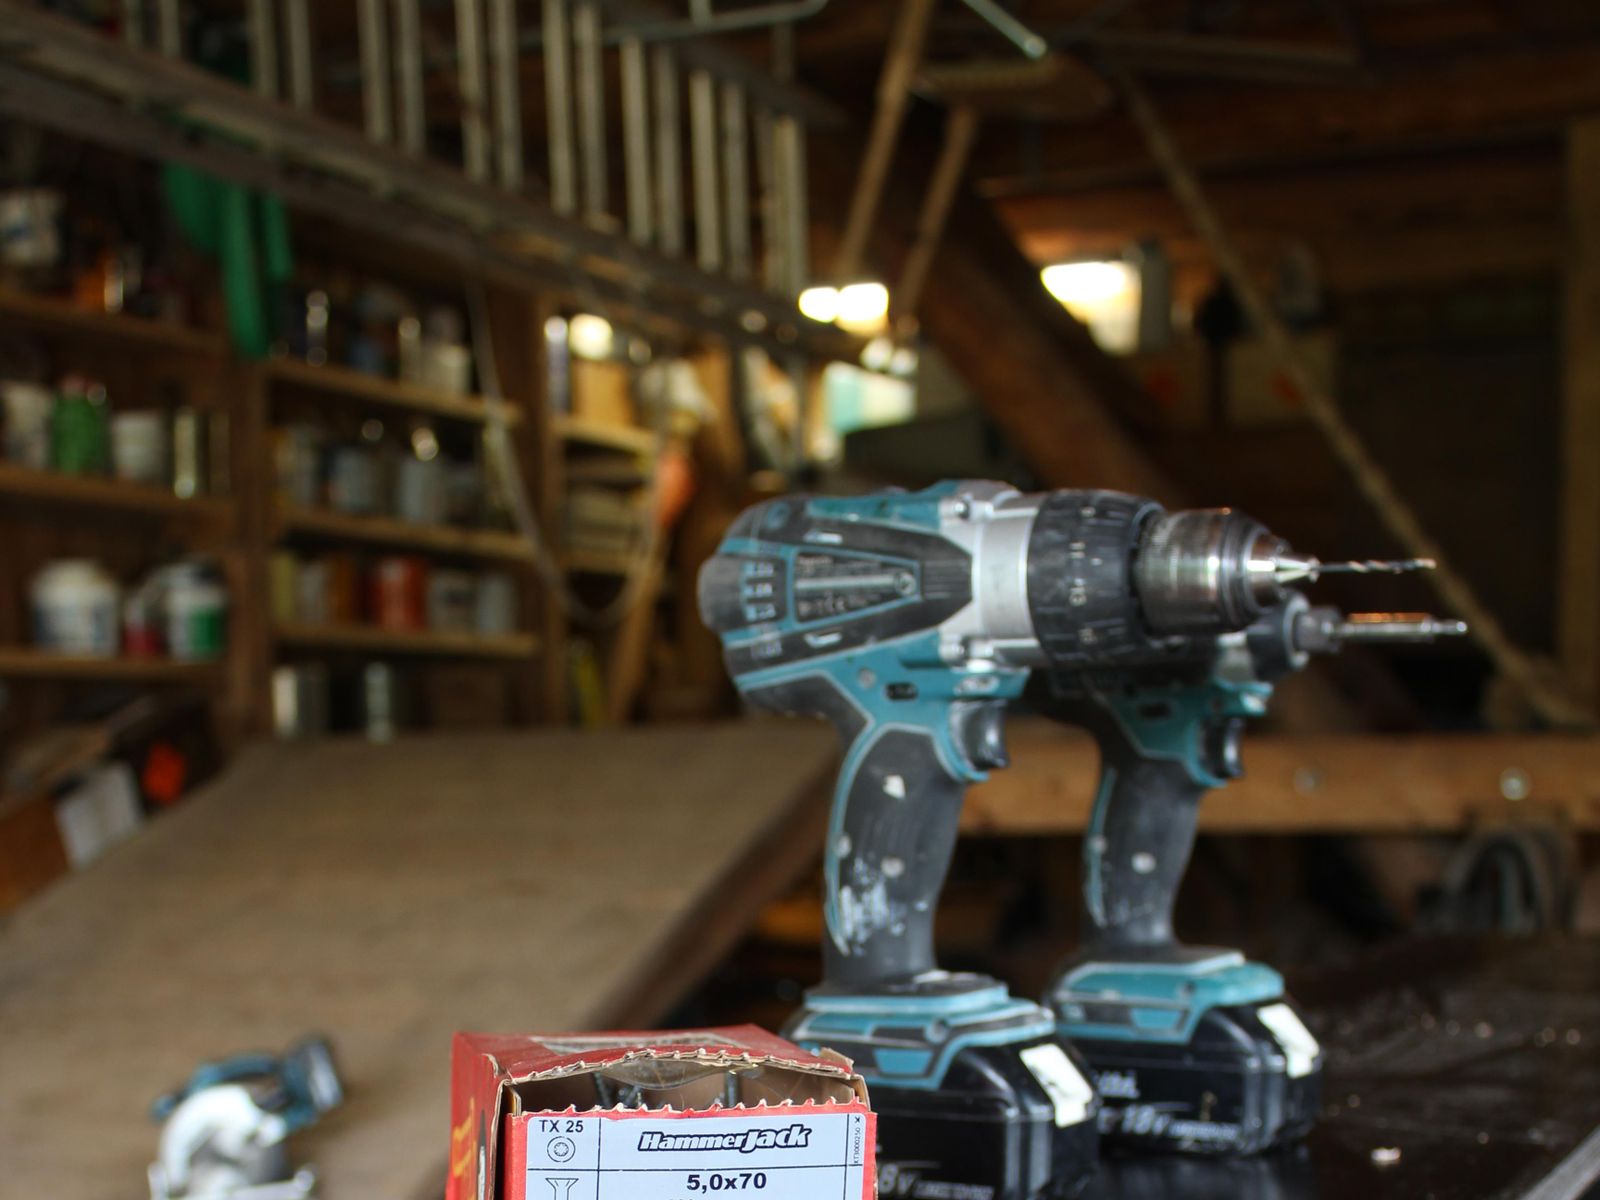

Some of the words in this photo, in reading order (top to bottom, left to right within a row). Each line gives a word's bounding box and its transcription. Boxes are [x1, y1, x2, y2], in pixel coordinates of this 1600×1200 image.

[539, 1120, 560, 1133] TX
[566, 1120, 584, 1133] 25
[686, 1172, 767, 1193] 5,0x70
